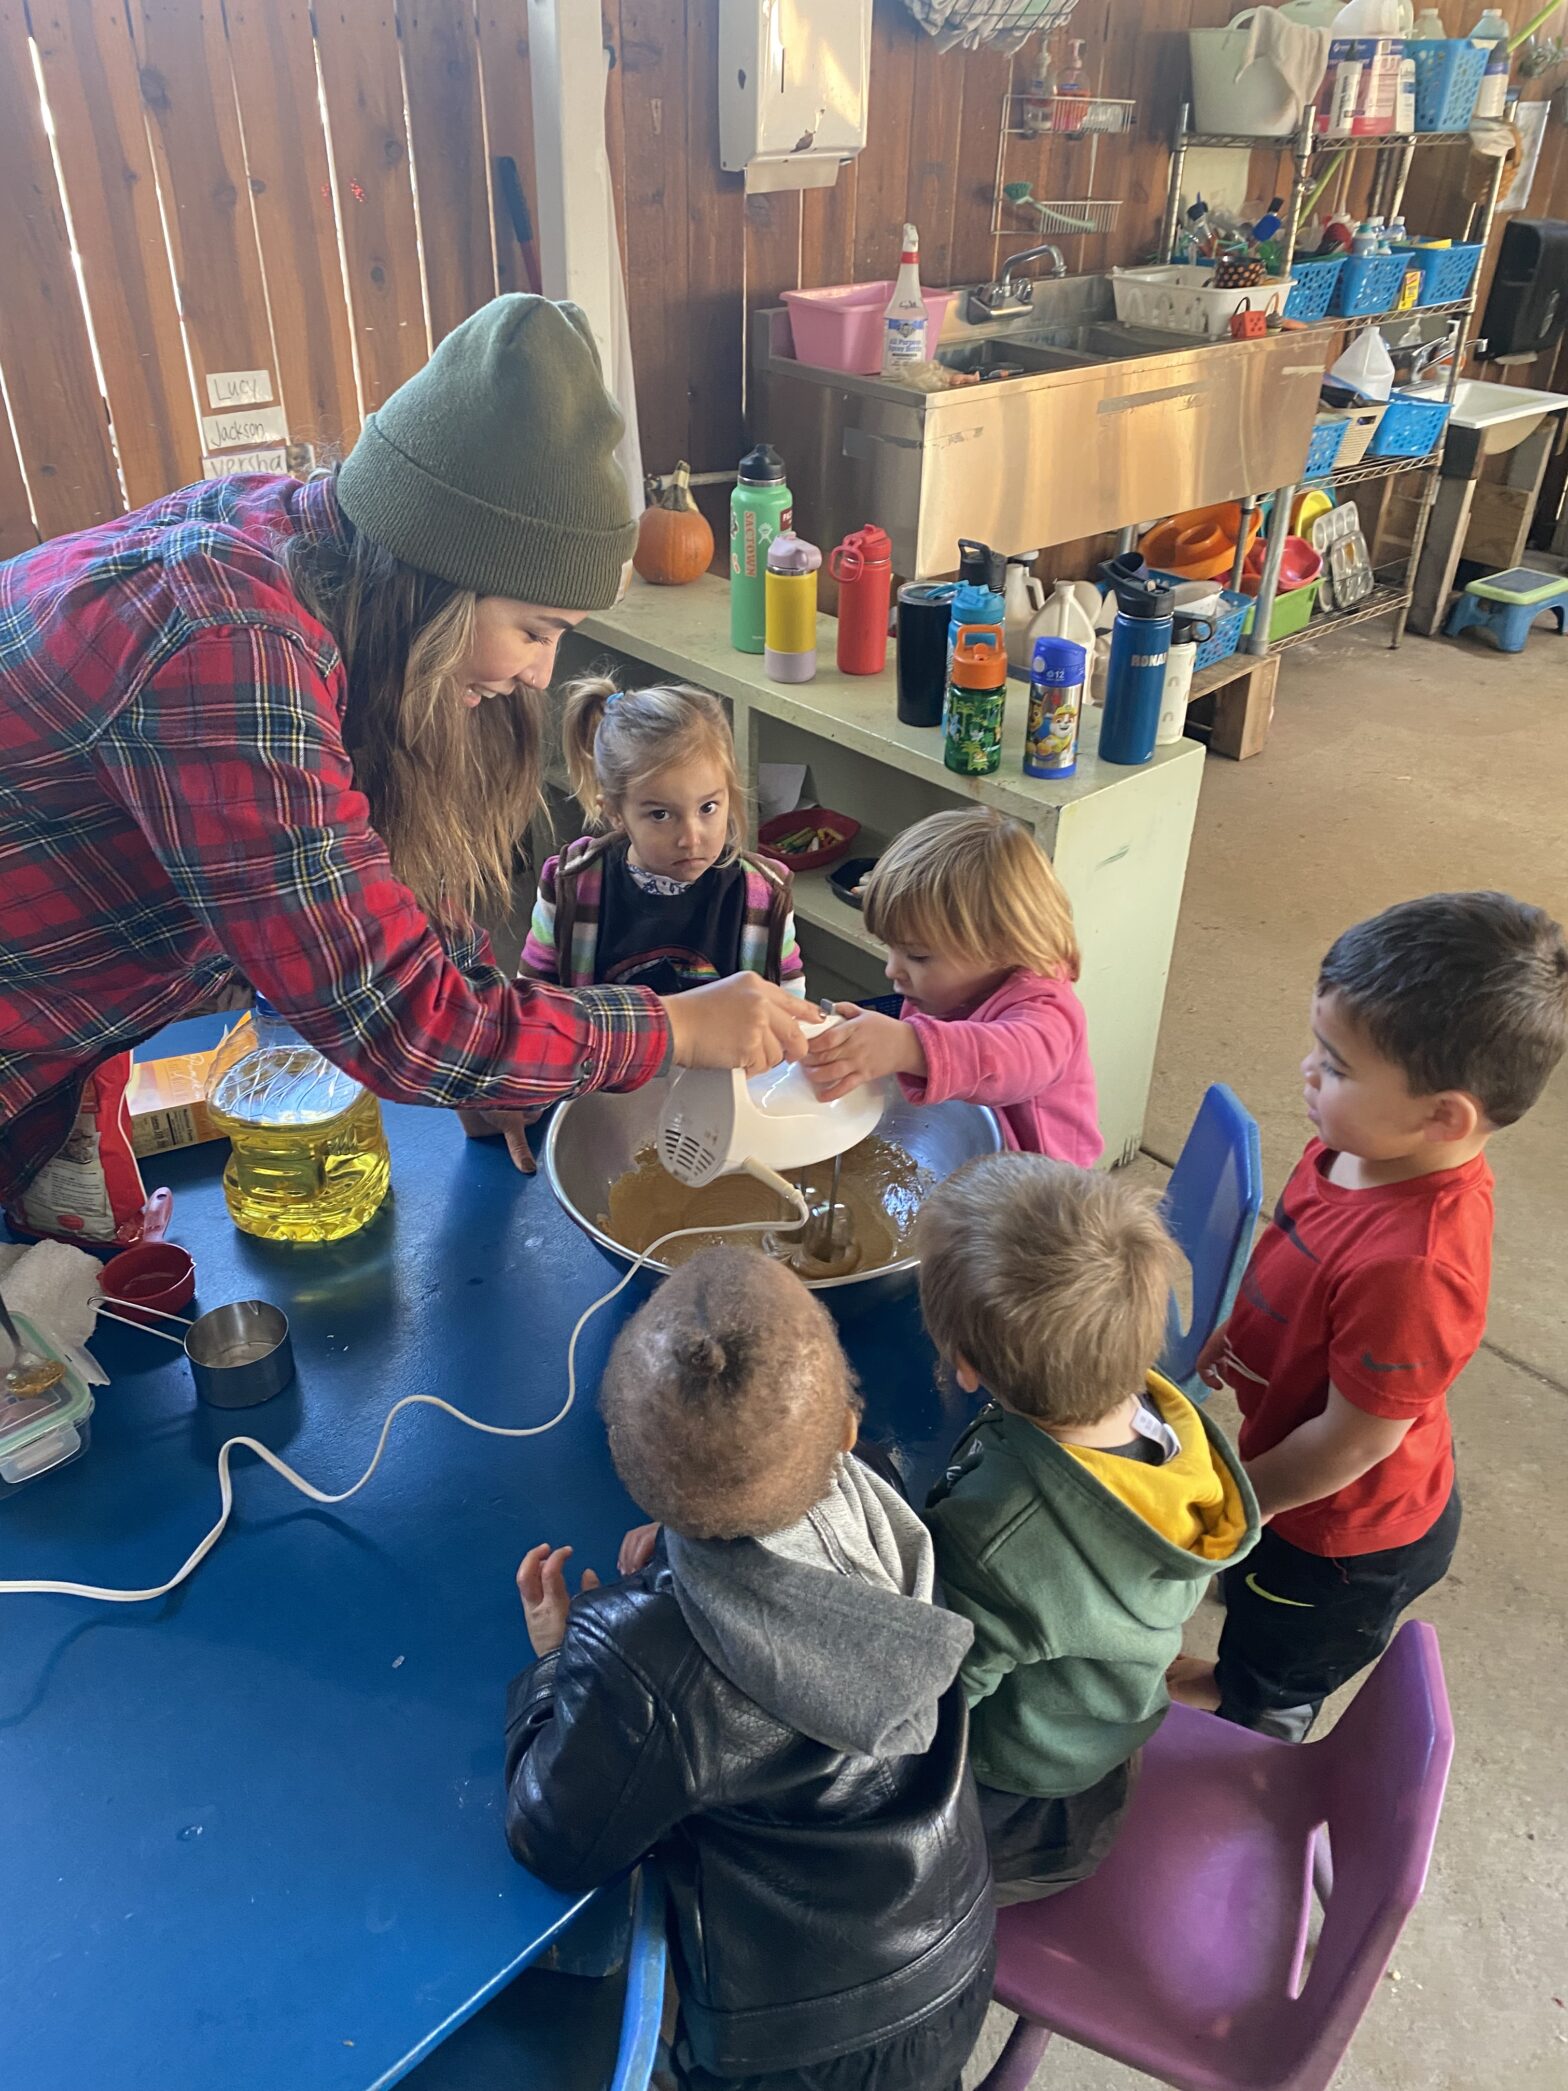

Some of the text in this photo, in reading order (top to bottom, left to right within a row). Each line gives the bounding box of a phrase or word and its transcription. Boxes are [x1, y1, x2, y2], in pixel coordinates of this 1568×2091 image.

[213, 379, 257, 401] Lucy
[210, 421, 265, 448] Jackson
[745, 511, 756, 576] SACTOWN
